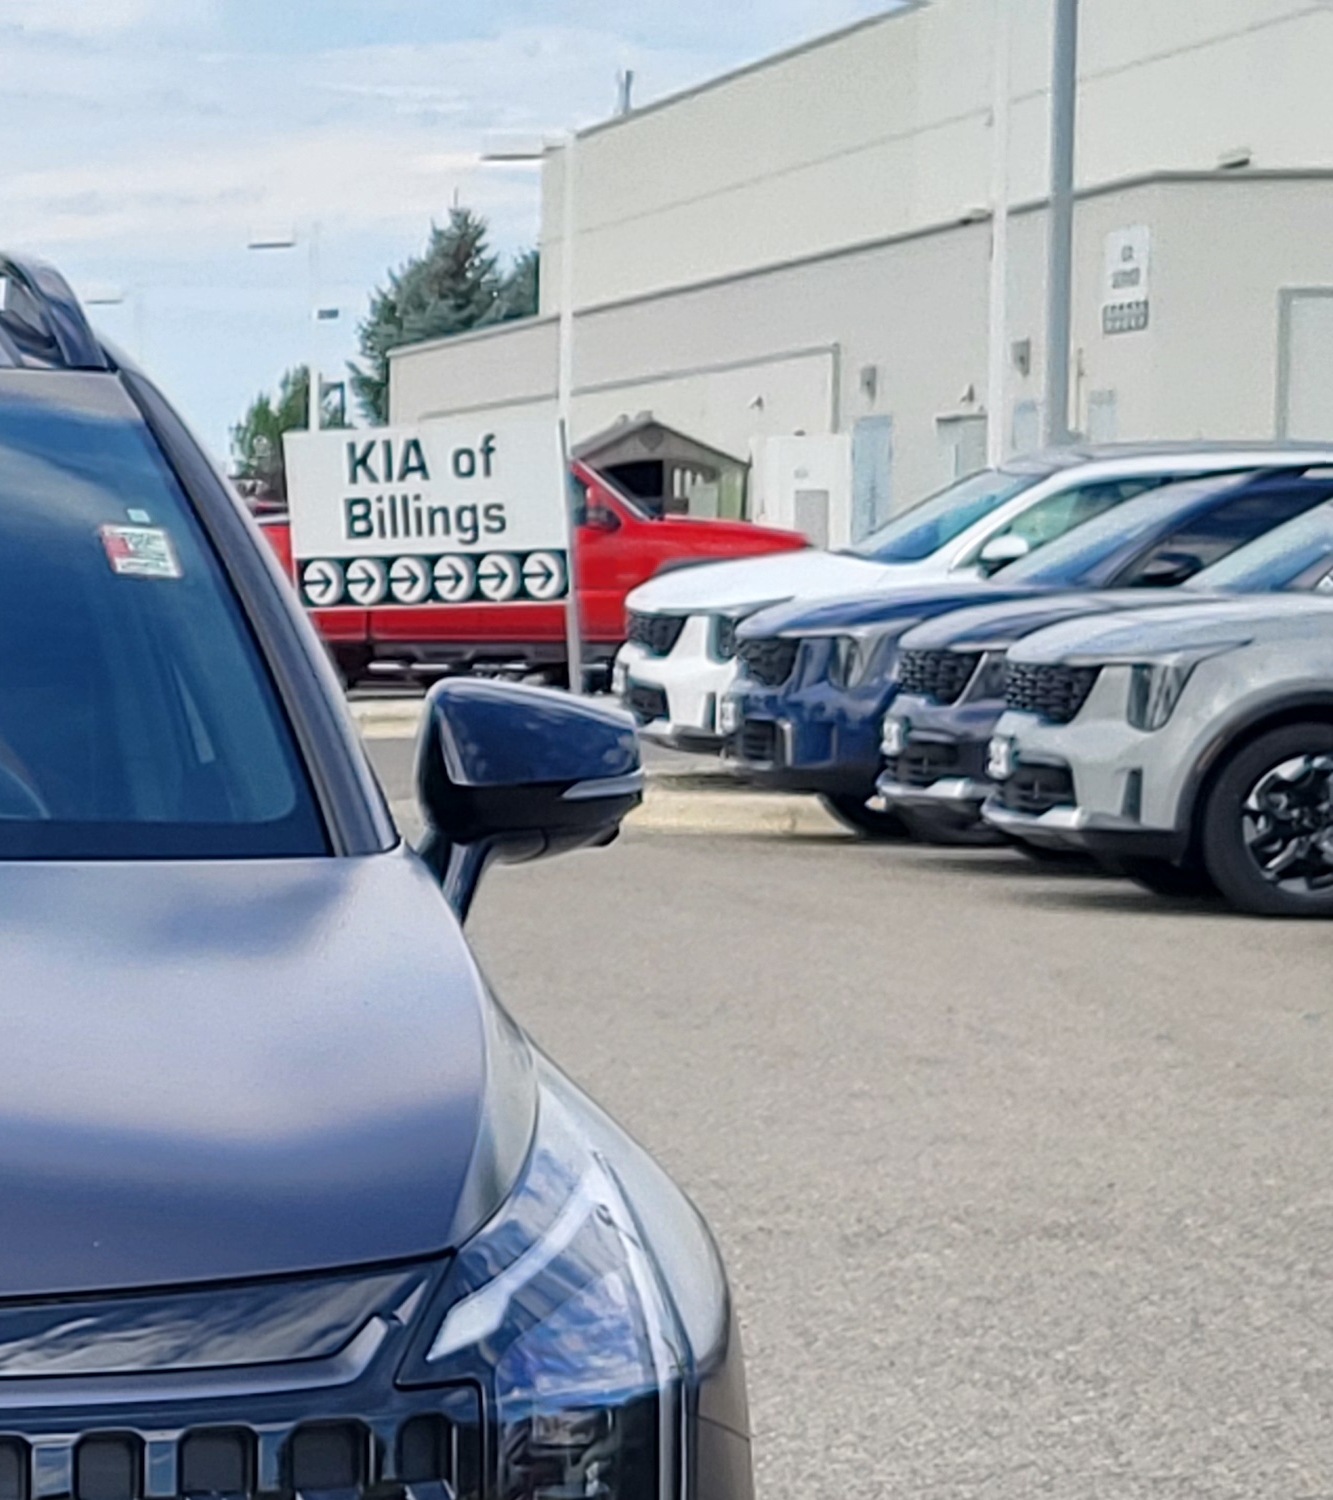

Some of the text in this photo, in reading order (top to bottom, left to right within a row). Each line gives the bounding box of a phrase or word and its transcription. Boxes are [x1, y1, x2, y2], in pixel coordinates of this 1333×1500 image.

[346, 433, 498, 485] KIA of
[344, 493, 507, 544] Billings
